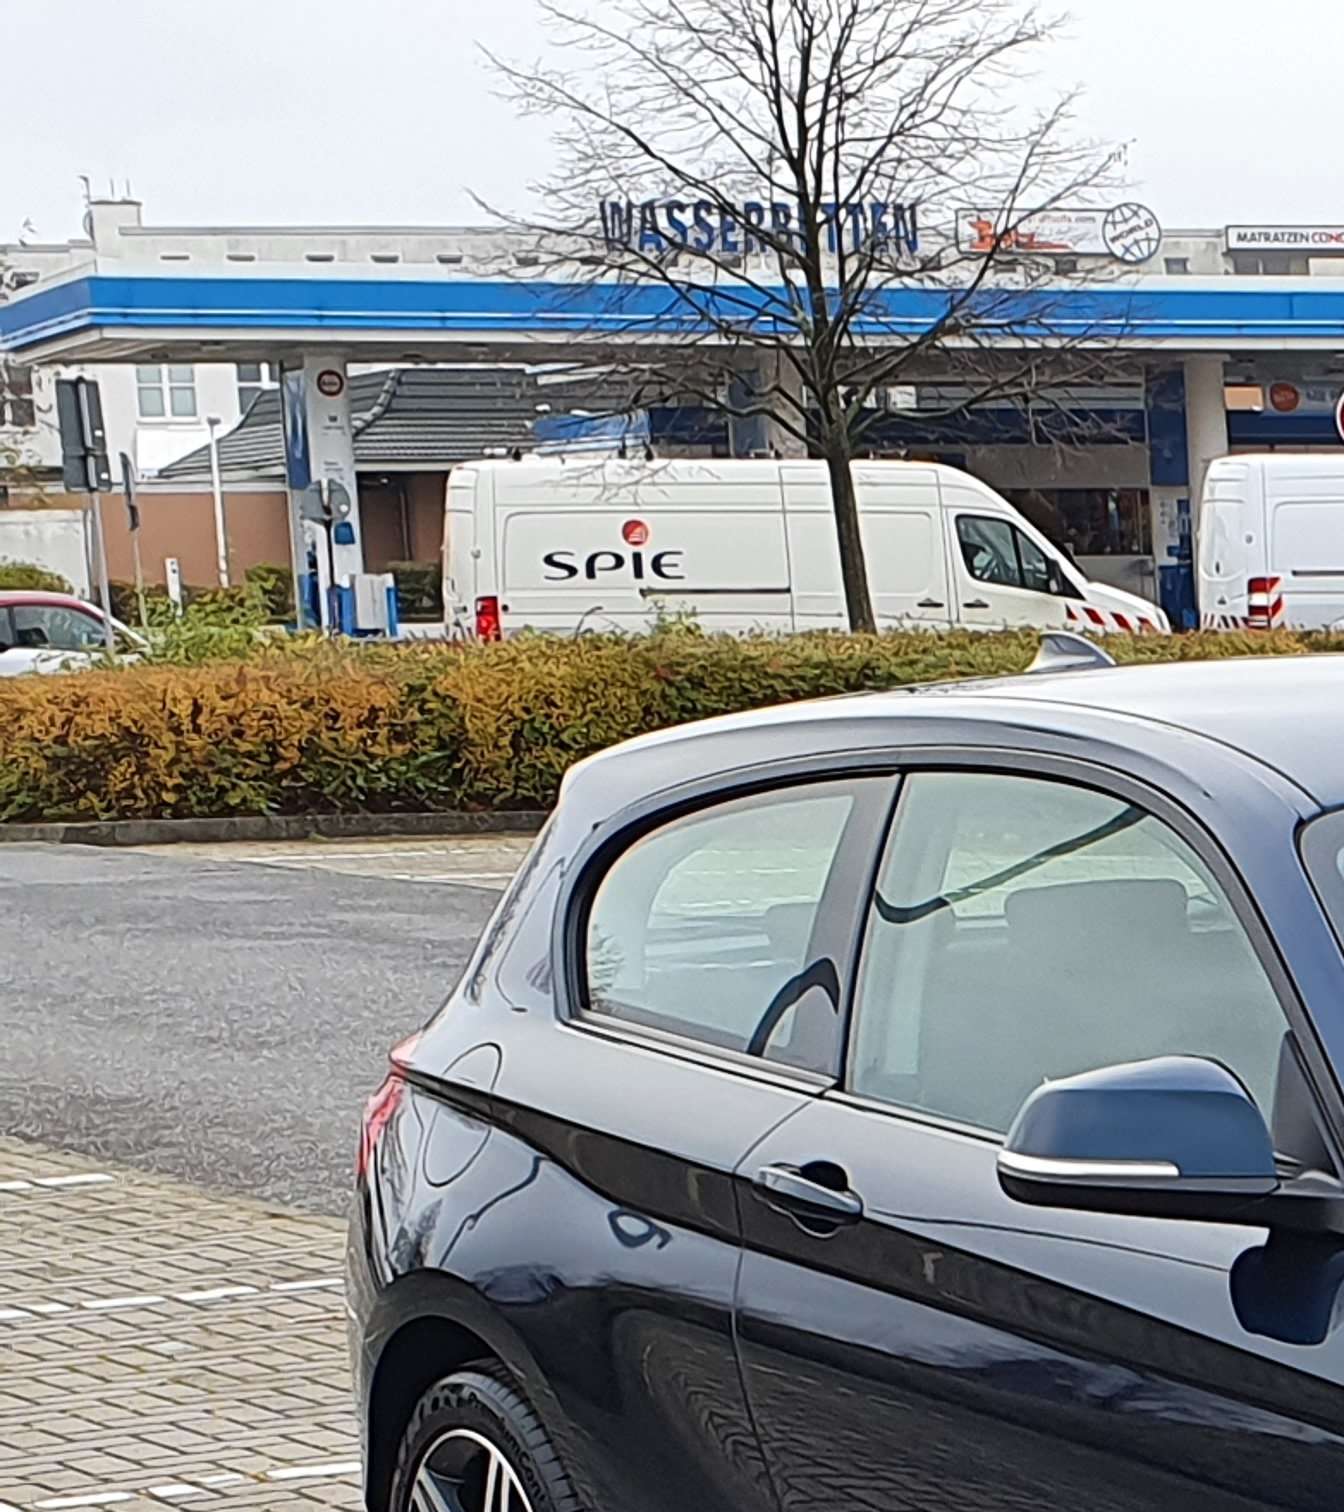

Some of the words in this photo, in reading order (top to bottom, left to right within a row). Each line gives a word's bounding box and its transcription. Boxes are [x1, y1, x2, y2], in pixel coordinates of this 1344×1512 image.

[599, 199, 919, 254] WASSERBTTEN
[1236, 231, 1309, 243] MATRATZEN
[543, 551, 685, 581] SPIE
